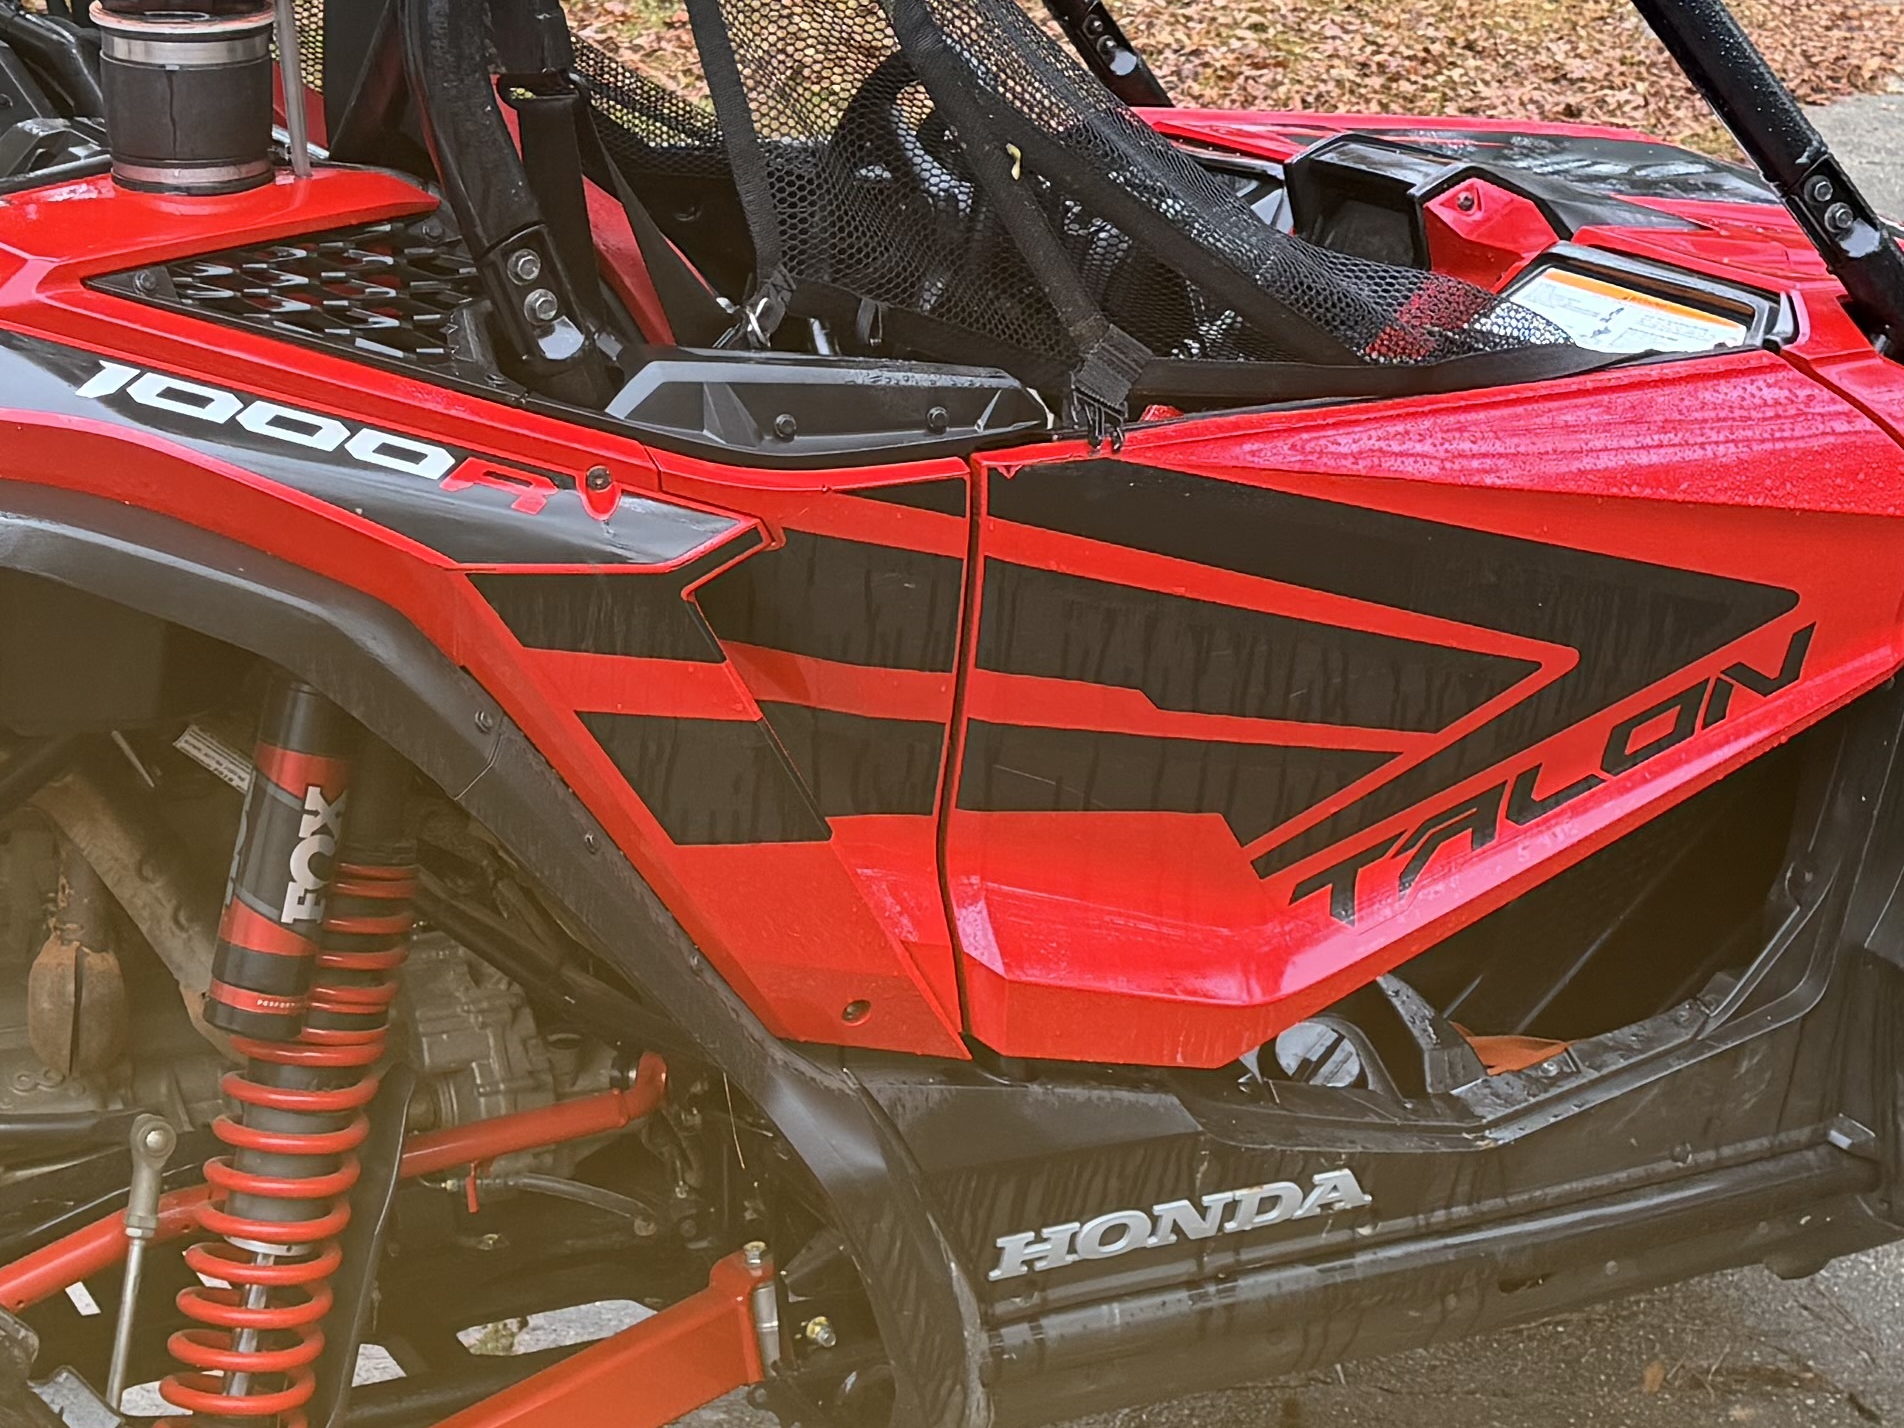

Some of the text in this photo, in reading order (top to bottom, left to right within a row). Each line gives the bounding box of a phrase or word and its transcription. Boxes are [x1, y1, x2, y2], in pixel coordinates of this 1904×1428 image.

[1288, 620, 1817, 928] TALON
[280, 784, 347, 925] FOX
[988, 1167, 1373, 1283] HONDA
